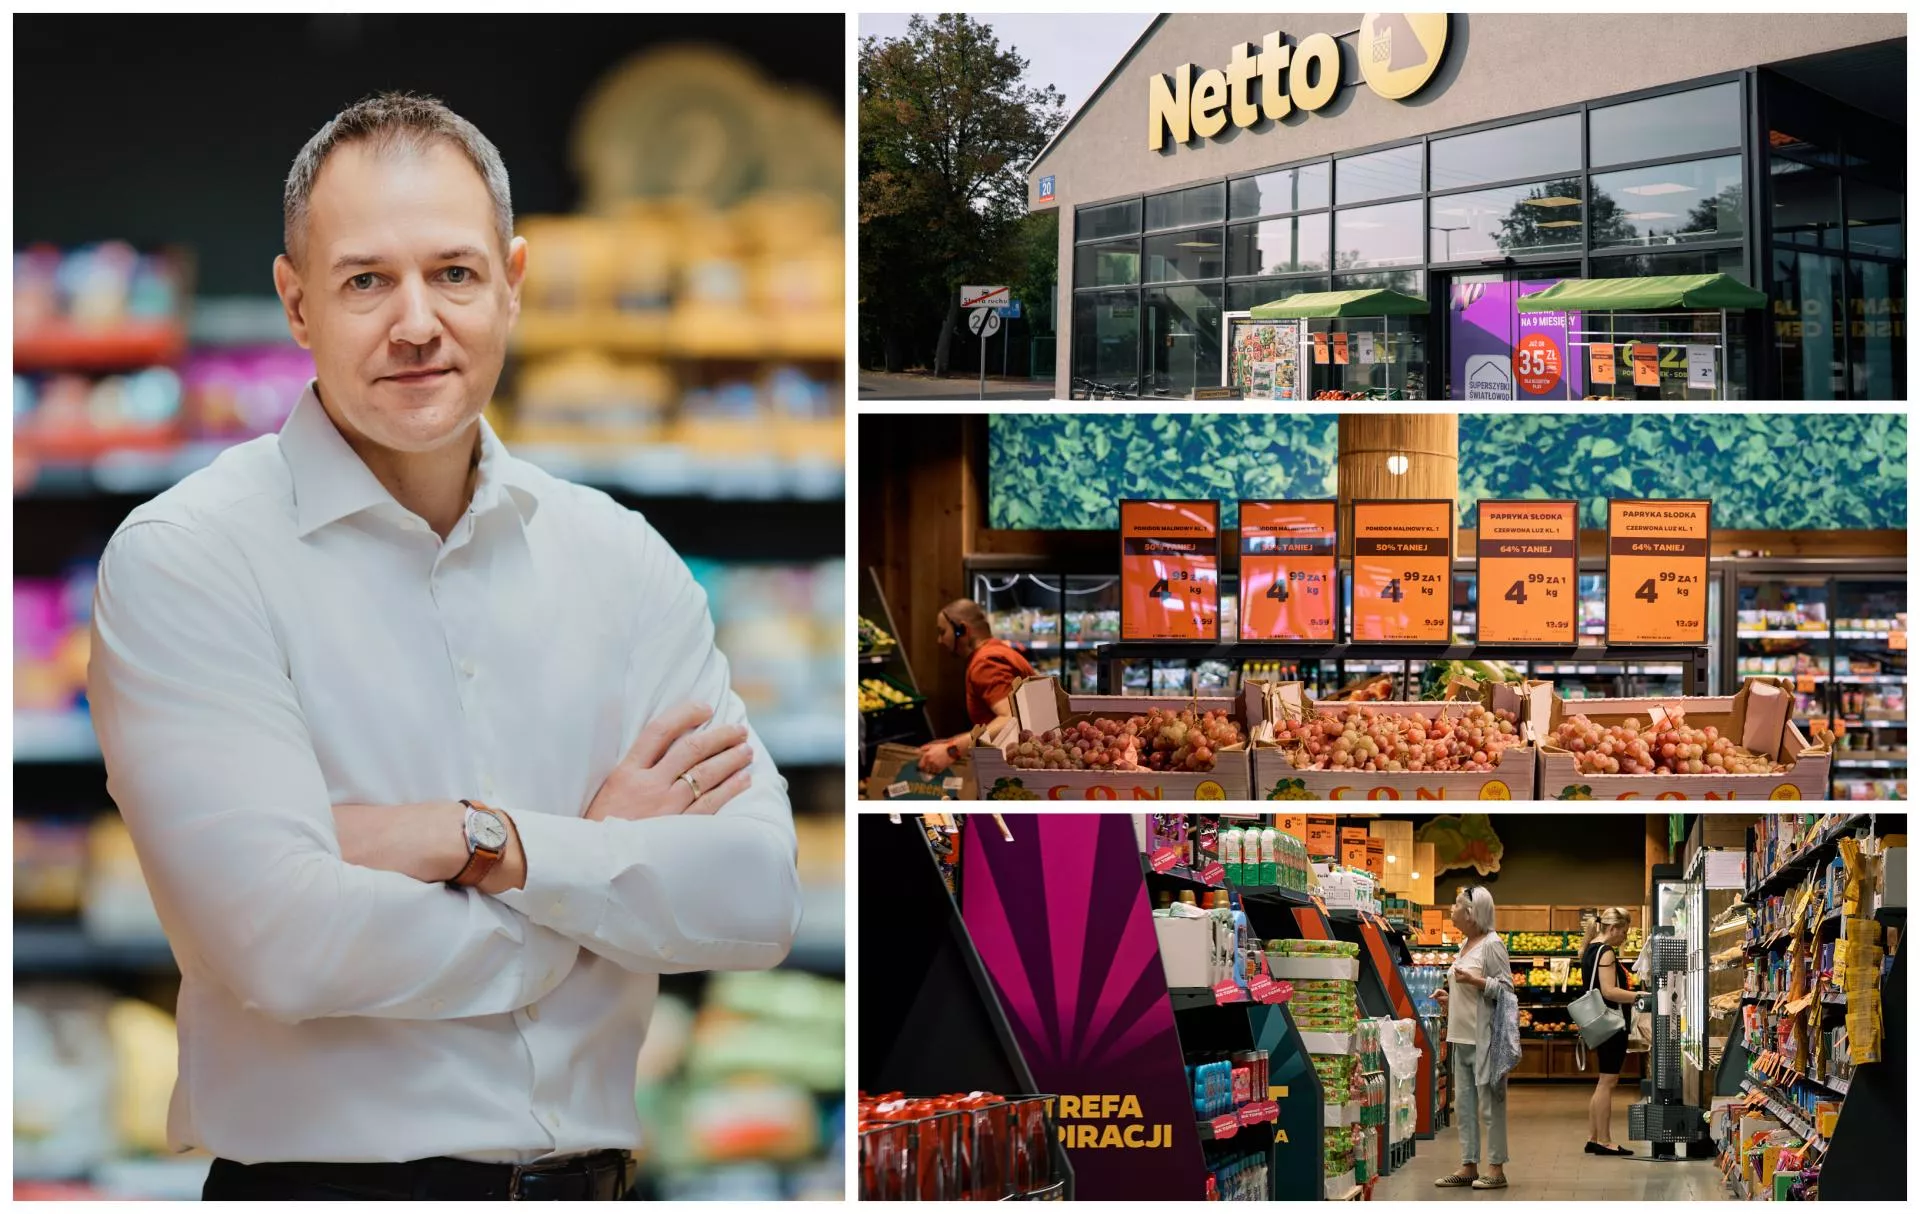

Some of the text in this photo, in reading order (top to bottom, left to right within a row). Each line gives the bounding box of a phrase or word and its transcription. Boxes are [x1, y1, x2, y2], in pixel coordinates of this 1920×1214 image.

[1149, 30, 1345, 152] Netto
[1042, 181, 1051, 196] 20
[972, 315, 998, 329] 20
[1533, 318, 1538, 326] 9
[1539, 316, 1576, 328] MIESIĘY
[1519, 349, 1545, 376] 35
[1598, 365, 1603, 373] 5
[1641, 366, 1646, 375] 3
[1469, 381, 1510, 391] SUPERSZYBKI
[1653, 544, 1685, 552] TANIEJ
[1149, 578, 1172, 602] 4
[1172, 571, 1188, 580] 99
[1190, 586, 1202, 594] kg
[1266, 572, 1327, 602] 4 99 ZA 1
[1306, 586, 1319, 596] kg
[1381, 578, 1404, 602] 4
[1404, 572, 1420, 581] 99
[1422, 586, 1434, 596] kg
[1504, 580, 1528, 604] 4
[1528, 574, 1544, 583] 99
[1635, 578, 1658, 603] 4
[1660, 572, 1676, 582] 99
[1677, 587, 1689, 596] kg
[1546, 588, 1558, 598] kg
[1284, 819, 1291, 828] 8
[1311, 830, 1322, 838] 25
